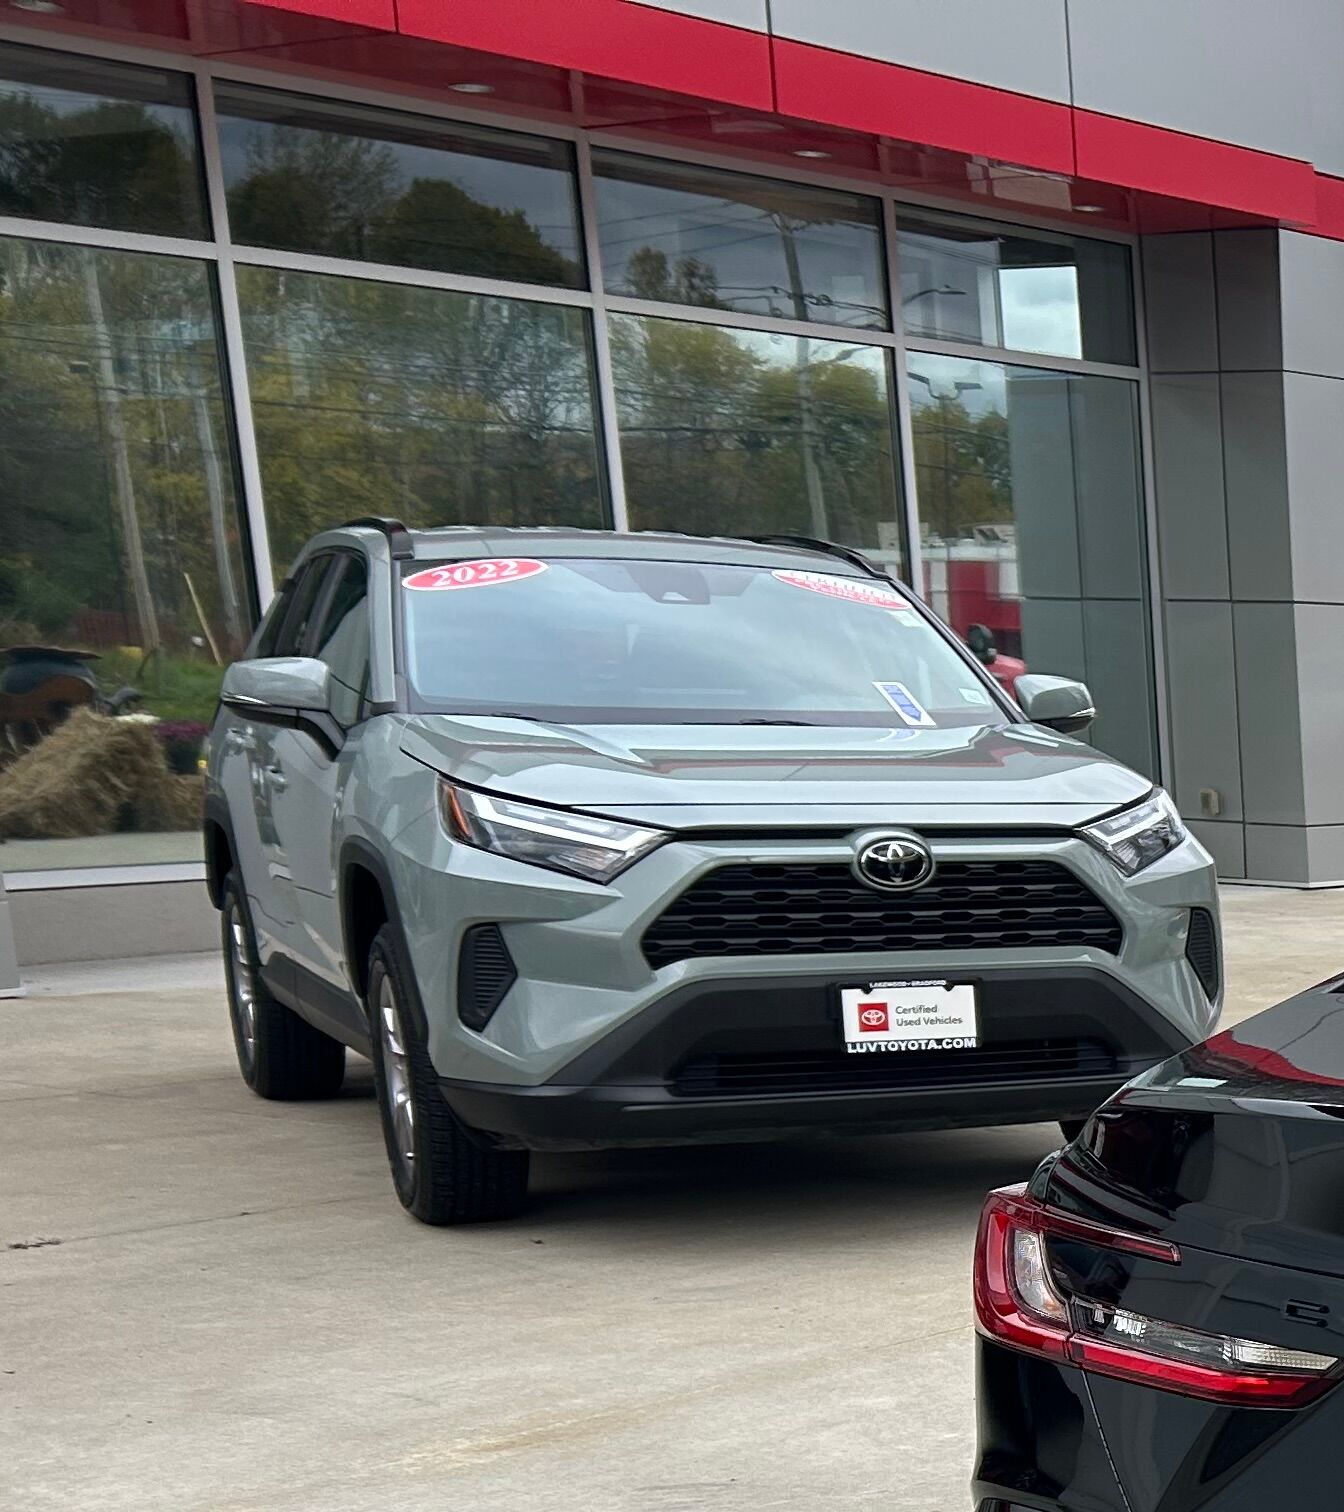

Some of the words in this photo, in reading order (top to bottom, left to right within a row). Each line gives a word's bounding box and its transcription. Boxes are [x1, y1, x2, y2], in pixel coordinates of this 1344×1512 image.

[432, 560, 520, 587] 2022
[895, 1004, 938, 1014] Certified
[895, 1017, 921, 1027] Used
[923, 1016, 963, 1026] Vehicles
[847, 1037, 977, 1053] LUVTOYOTA.COM
